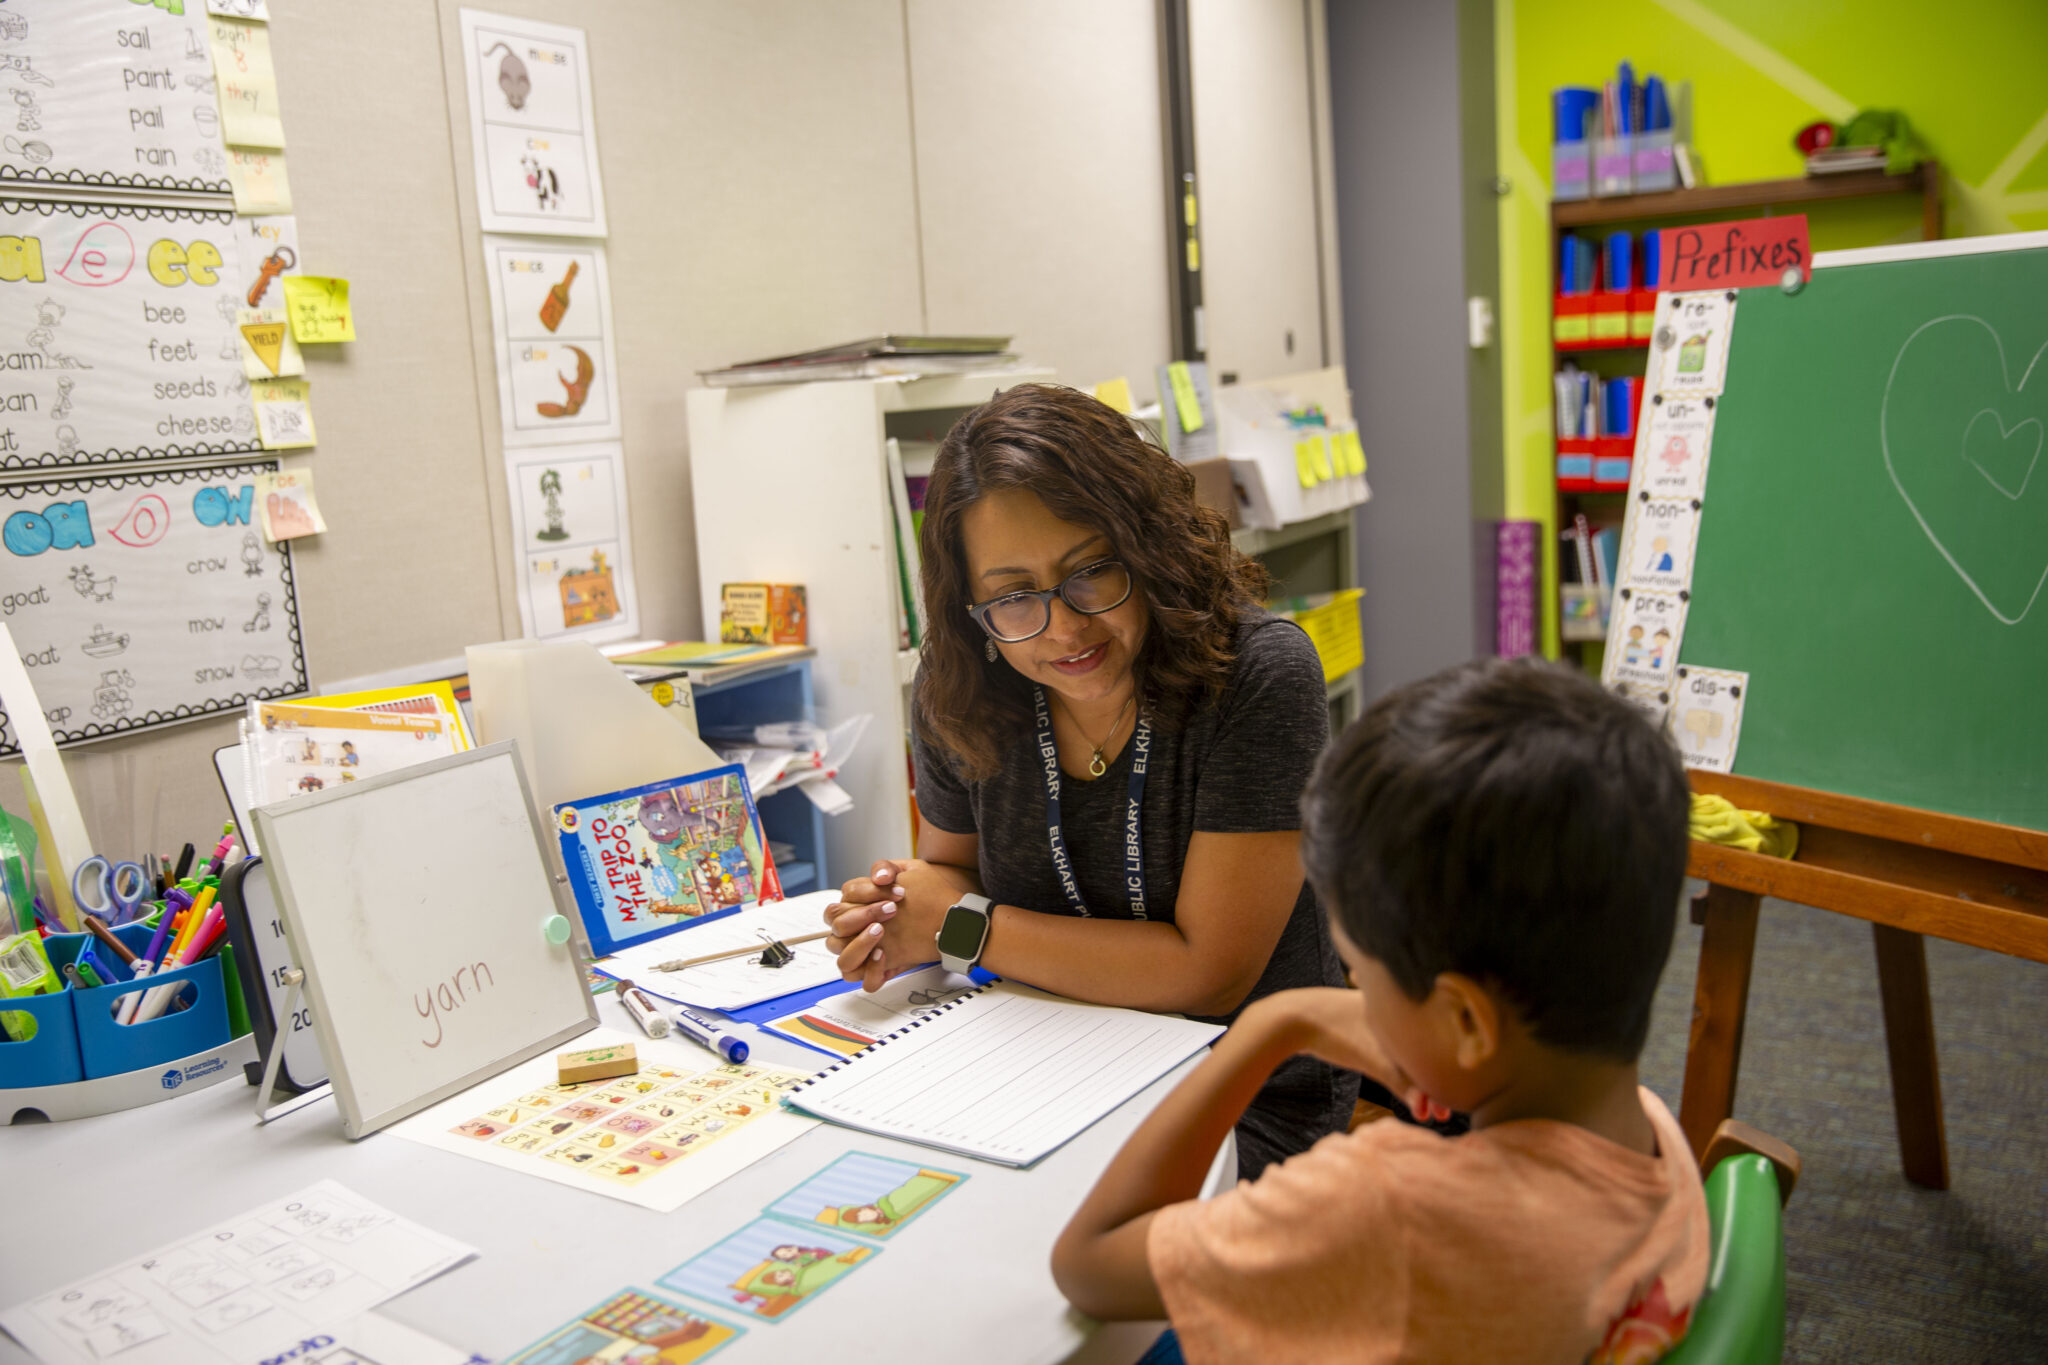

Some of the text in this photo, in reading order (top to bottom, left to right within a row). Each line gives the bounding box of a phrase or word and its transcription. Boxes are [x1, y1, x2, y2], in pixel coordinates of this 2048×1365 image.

[117, 26, 151, 50] sail
[123, 68, 176, 91] paint
[227, 85, 259, 112] they
[130, 106, 164, 131] pail
[135, 145, 177, 167] rain
[251, 217, 282, 242] key
[1671, 228, 1801, 284] Prefixes
[143, 300, 187, 324] bee
[251, 330, 280, 346] YIELD
[148, 339, 198, 362] feet
[154, 376, 217, 400] seeds
[157, 414, 233, 437] cheese
[193, 485, 254, 527] ow
[3, 500, 95, 556] oa
[186, 557, 228, 575] crow
[2, 584, 50, 616] goat
[189, 616, 226, 634] mow
[21, 645, 61, 669] oat
[195, 665, 235, 685] snow
[44, 706, 72, 726] ap
[369, 714, 402, 726] Vowel
[1033, 686, 1059, 801] BLIC LIBRARY
[1133, 698, 1157, 774] ELKHA
[1128, 798, 1141, 872] LIBRARY
[592, 818, 638, 922] MY TRIP TO
[611, 825, 649, 909] THE ZOO
[1050, 825, 1081, 902] ELKHART
[414, 961, 494, 1048] yarn
[292, 1008, 312, 1032] 20
[184, 1057, 220, 1074] Learning
